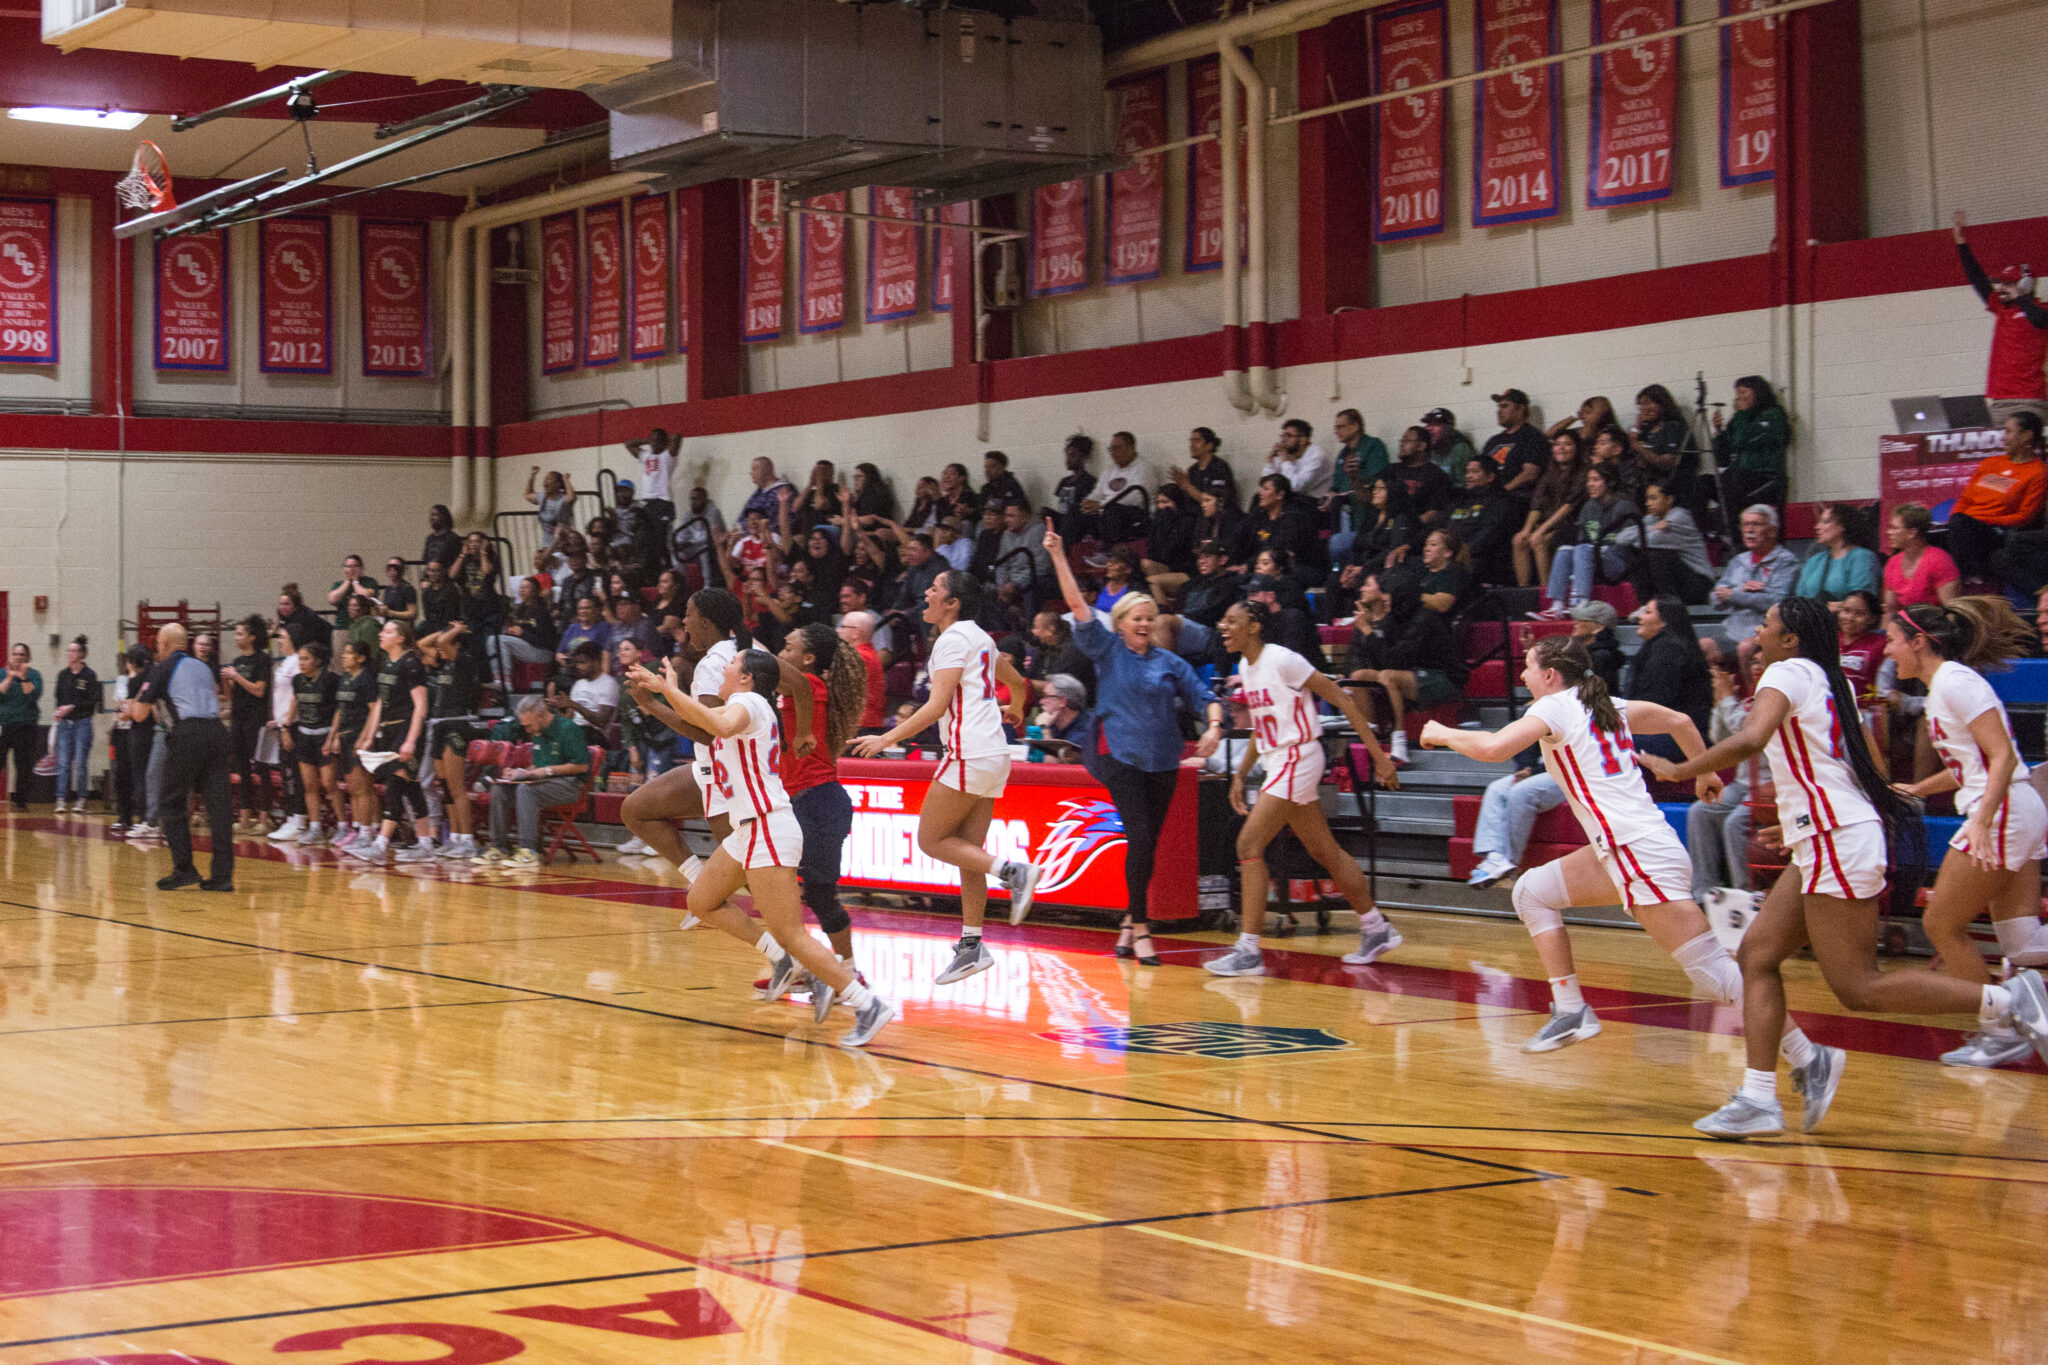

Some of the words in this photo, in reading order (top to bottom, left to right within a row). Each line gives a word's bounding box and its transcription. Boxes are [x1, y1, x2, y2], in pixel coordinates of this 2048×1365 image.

[1603, 148, 1669, 190] 2017
[1486, 169, 1549, 210] 2014
[1384, 189, 1439, 226] 2010
[2, 329, 48, 352] 998
[164, 337, 219, 361] 2007
[269, 341, 322, 363] 2012
[369, 344, 423, 367] 2013
[866, 785, 904, 809] THE
